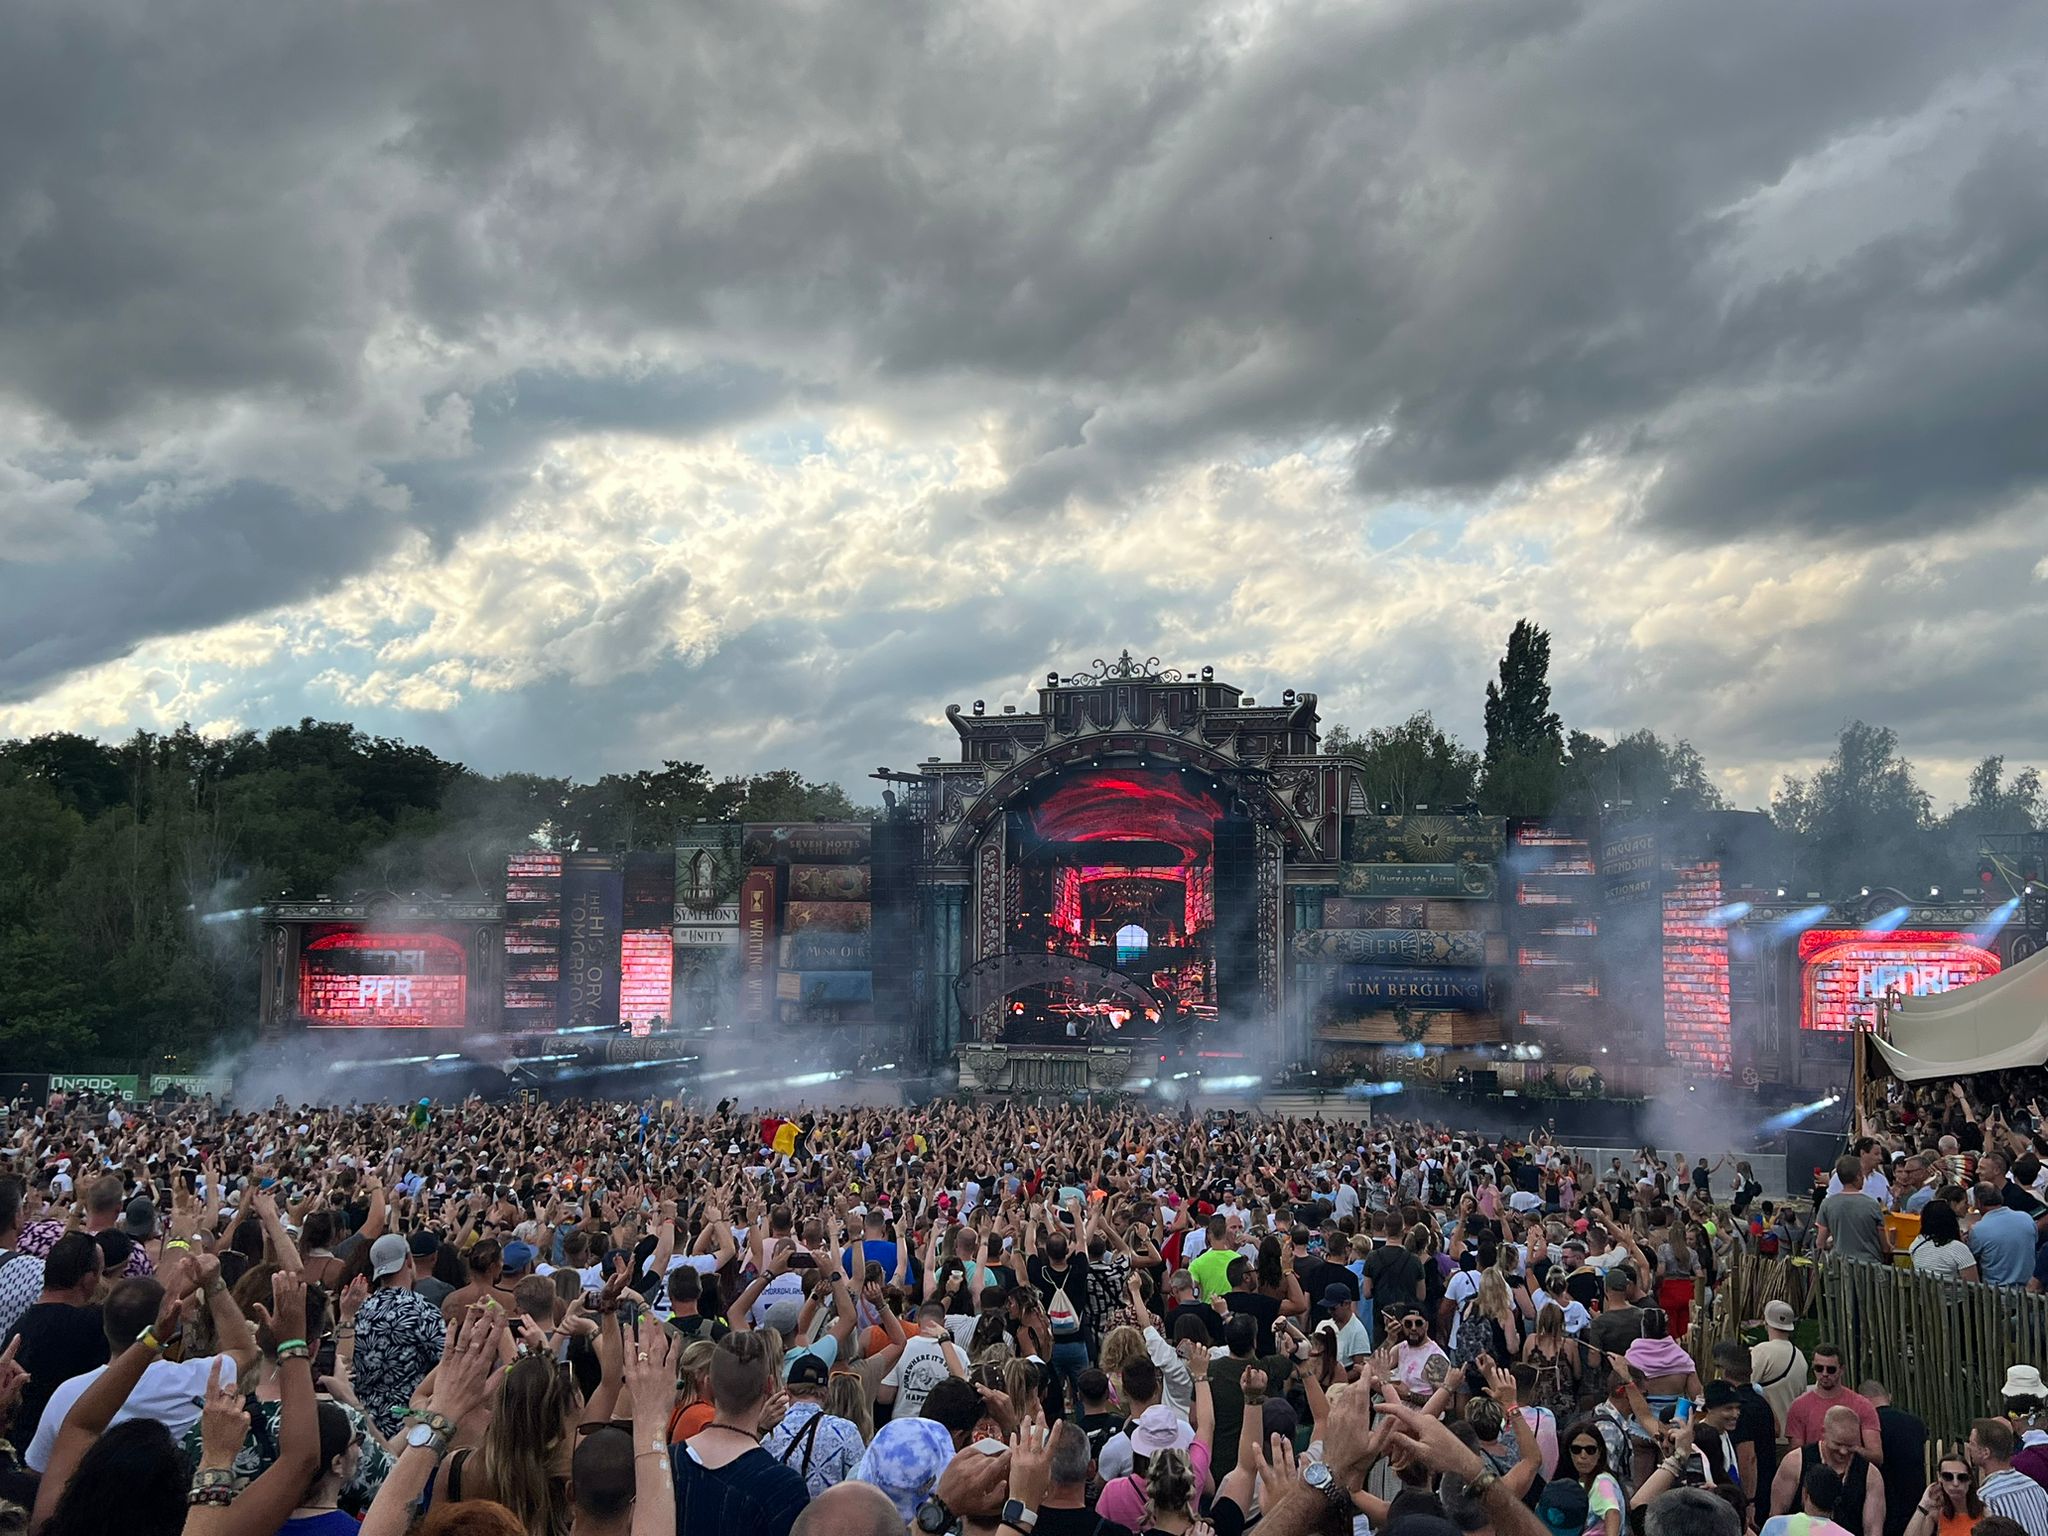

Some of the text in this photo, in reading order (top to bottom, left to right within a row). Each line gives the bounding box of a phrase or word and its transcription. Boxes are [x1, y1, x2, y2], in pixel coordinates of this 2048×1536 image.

[789, 839, 861, 849] SEVEN NOTES
[808, 847, 852, 856] SILENCE
[1602, 837, 1655, 860] LANGUAGE
[1602, 855, 1657, 876] FRIENDSHIP
[589, 888, 600, 915] THE
[674, 908, 739, 922] SYMPHONY
[689, 930, 724, 943] UNITY
[749, 918, 764, 971] WRITING
[360, 980, 412, 1007] PFR
[1345, 982, 1479, 997] TIM BERGLING
[905, 1393, 927, 1402] HAPP
